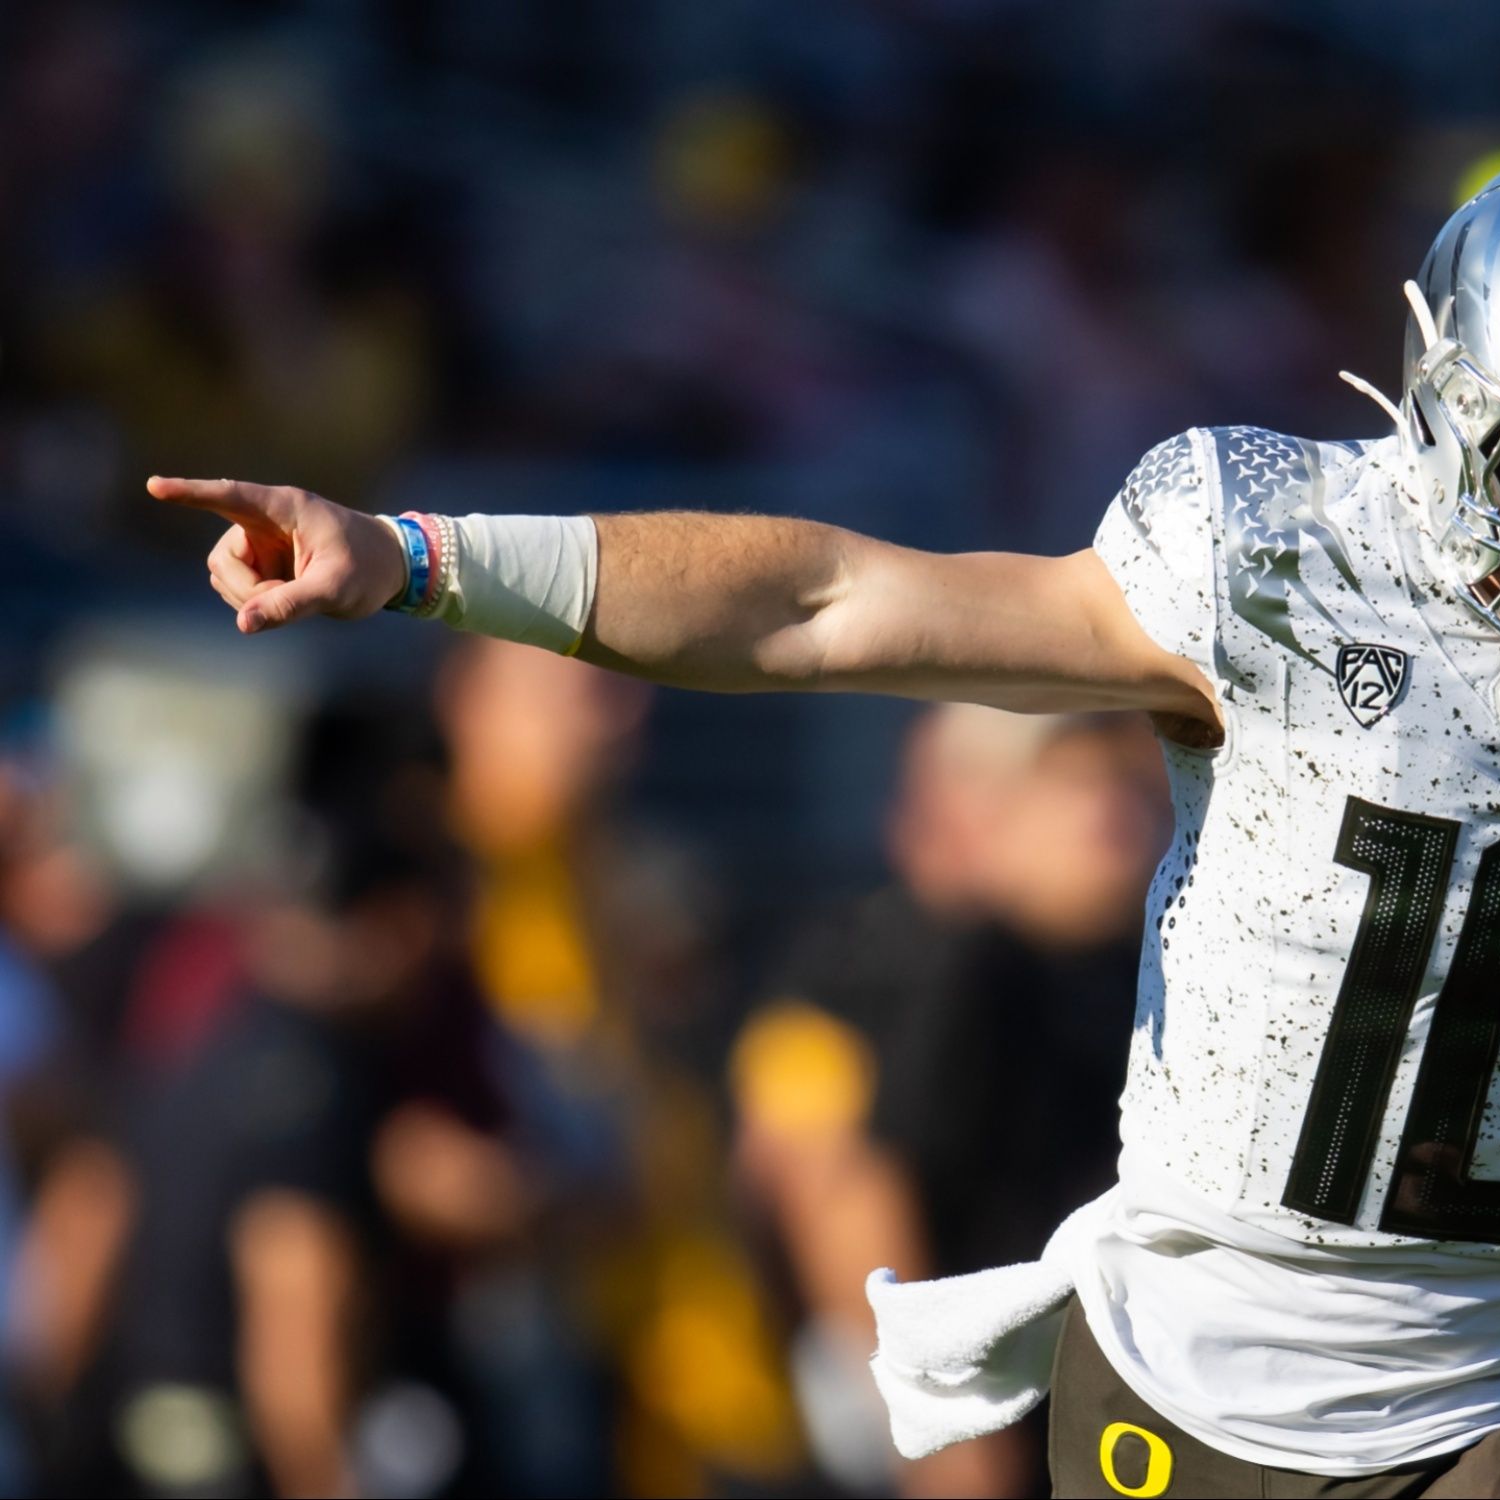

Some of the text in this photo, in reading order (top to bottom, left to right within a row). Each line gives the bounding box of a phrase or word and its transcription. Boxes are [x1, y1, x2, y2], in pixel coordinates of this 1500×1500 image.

[1341, 648, 1403, 697] PAC
[1350, 680, 1385, 711] 12
[1100, 1421, 1173, 1498] O
